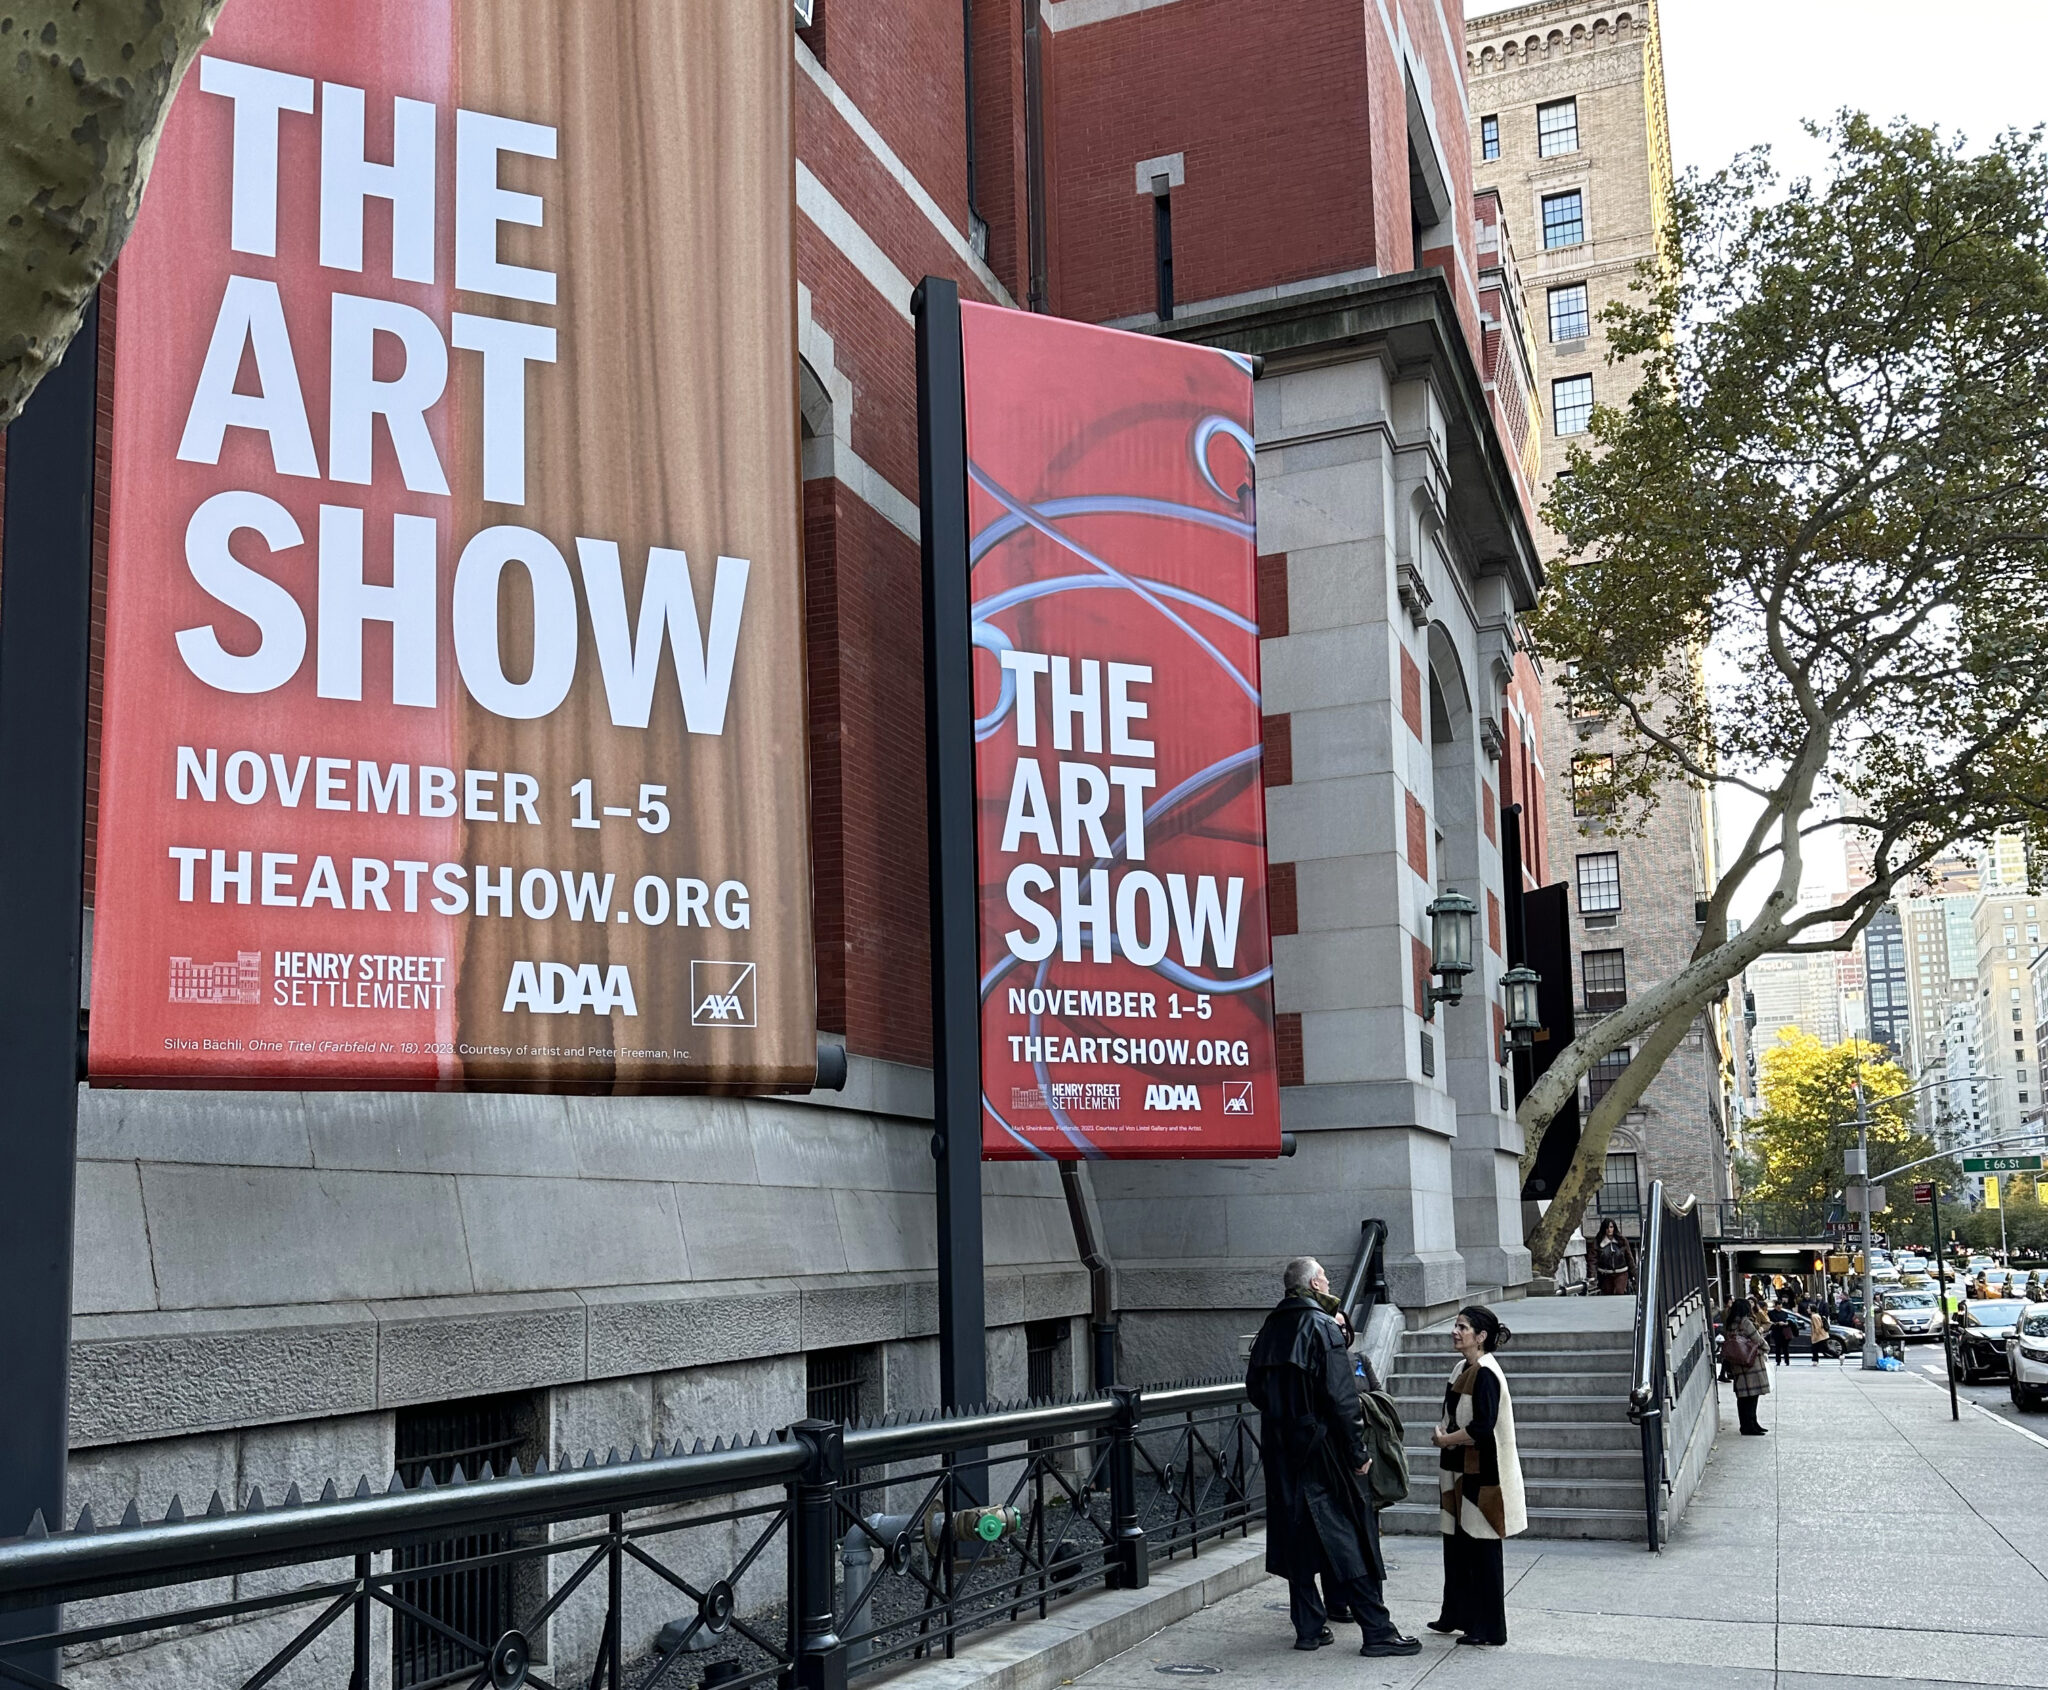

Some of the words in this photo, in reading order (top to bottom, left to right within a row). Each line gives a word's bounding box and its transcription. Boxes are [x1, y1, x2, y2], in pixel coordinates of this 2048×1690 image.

[200, 55, 556, 305] THE
[176, 274, 556, 506] ART
[174, 490, 750, 735] SHOW
[1001, 649, 1155, 758] THE
[176, 746, 541, 825] NOVEMBER
[1001, 757, 1156, 861] ART
[168, 846, 751, 930] THEARTSHOW.ORG
[1005, 863, 1244, 969] SHOW
[274, 951, 354, 979] HENRY
[359, 954, 446, 982] STREET
[273, 979, 446, 1010] SETTLEMENT
[502, 960, 638, 1016] ADAA
[1008, 988, 1157, 1018] NOVEMBER
[693, 994, 744, 1020] AXA
[164, 1038, 199, 1050] Silvia
[203, 1038, 245, 1052] Bächli,
[249, 1039, 283, 1052] Ohne
[288, 1040, 316, 1053] Titel
[319, 1040, 376, 1054] (Farbfeld
[379, 1042, 397, 1054] Nr.
[401, 1042, 421, 1055] 18),
[459, 1043, 513, 1057] Courtesy
[516, 1044, 528, 1056] of
[530, 1045, 561, 1057] artist
[564, 1045, 585, 1057] and
[588, 1046, 618, 1058] Peter
[621, 1046, 671, 1060] Freeman,
[673, 1048, 692, 1060] Inc.
[1008, 1035, 1249, 1066] THEARTSHOW.ORG
[1051, 1083, 1084, 1096] HENRY
[1085, 1084, 1121, 1097] STREET
[1052, 1096, 1121, 1110] SETTLEMENT
[1144, 1084, 1201, 1111] ADAA
[1225, 1098, 1249, 1112] AXA
[1984, 1160, 1990, 1169] E
[1994, 1159, 2006, 1169] 66
[2009, 1159, 2020, 1168] St
